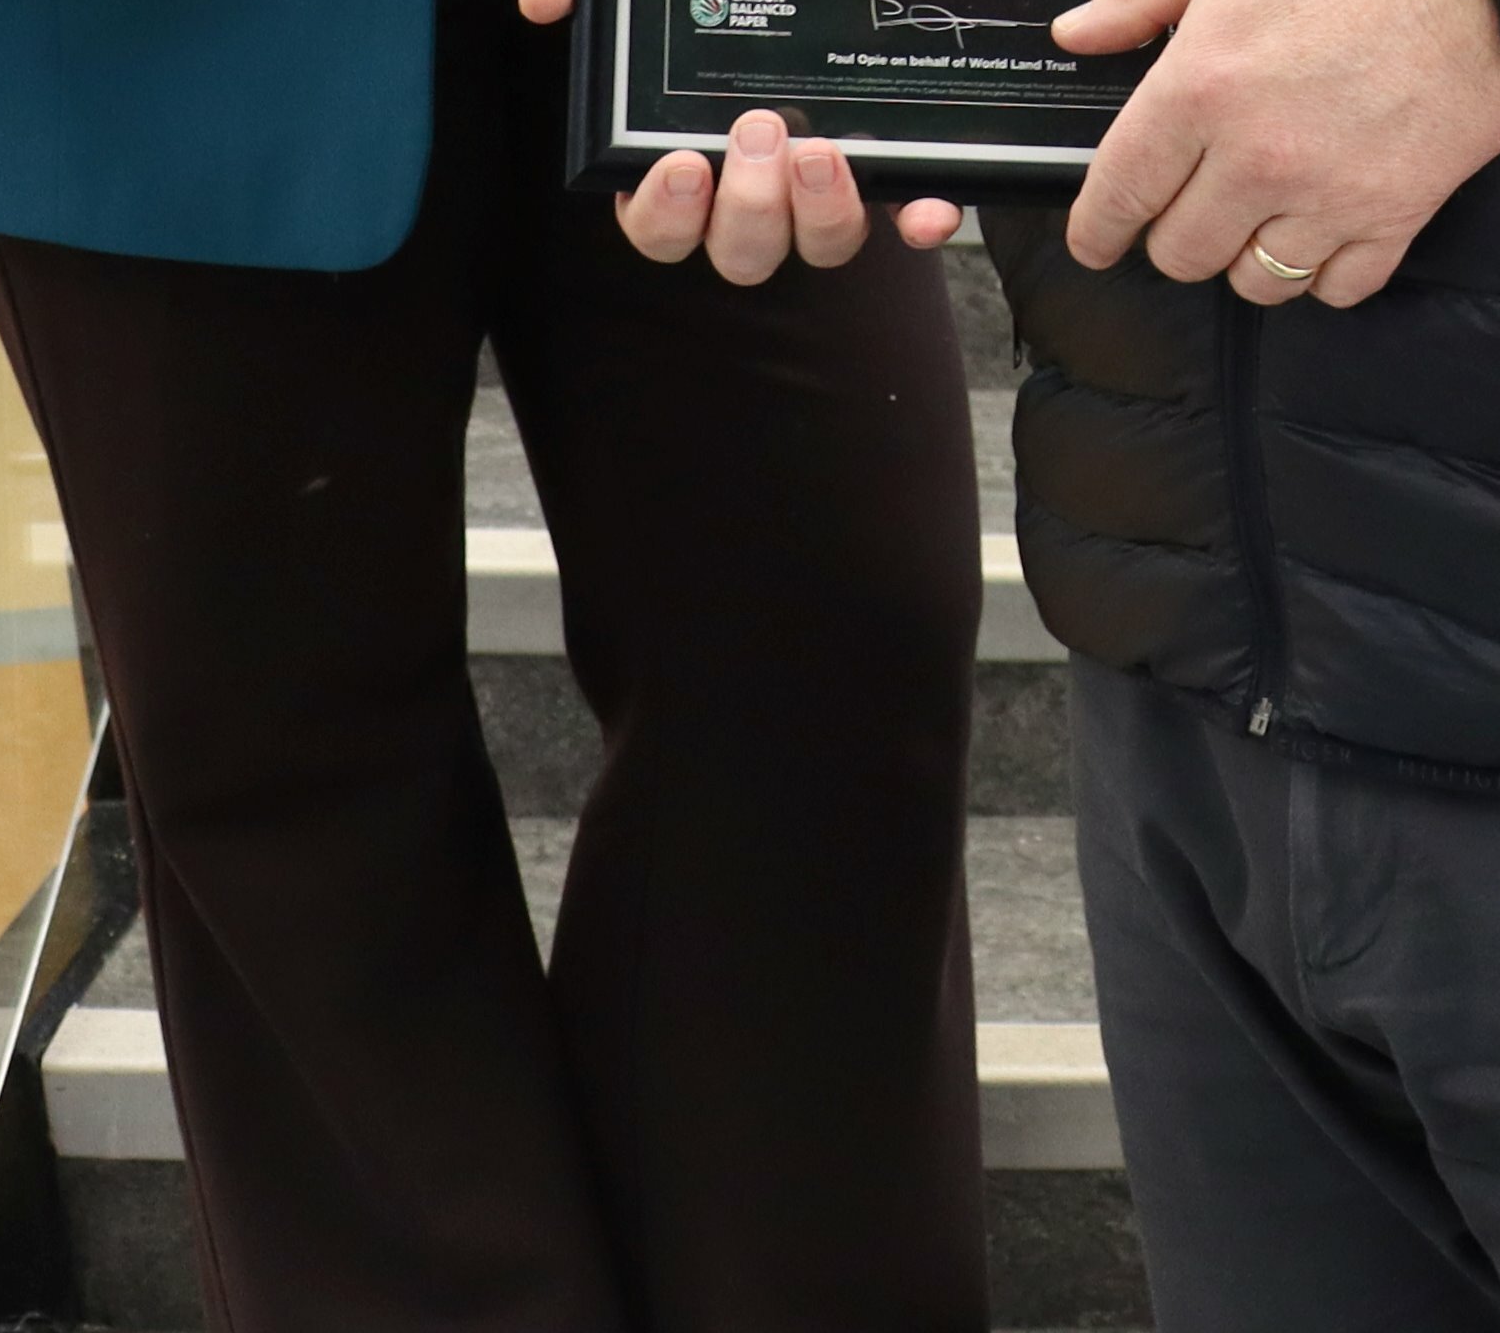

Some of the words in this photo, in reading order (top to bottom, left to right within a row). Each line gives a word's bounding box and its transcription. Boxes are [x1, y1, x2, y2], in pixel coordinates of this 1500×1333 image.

[730, 2, 796, 16] BALANCED
[728, 15, 768, 28] PAPER
[827, 52, 855, 65] Paul
[857, 54, 887, 67] Opie
[890, 56, 907, 66] on
[909, 54, 950, 68] behalf
[952, 57, 967, 68] of
[969, 57, 1007, 69] World
[1010, 59, 1043, 71] Land
[1045, 60, 1077, 71] Trust
